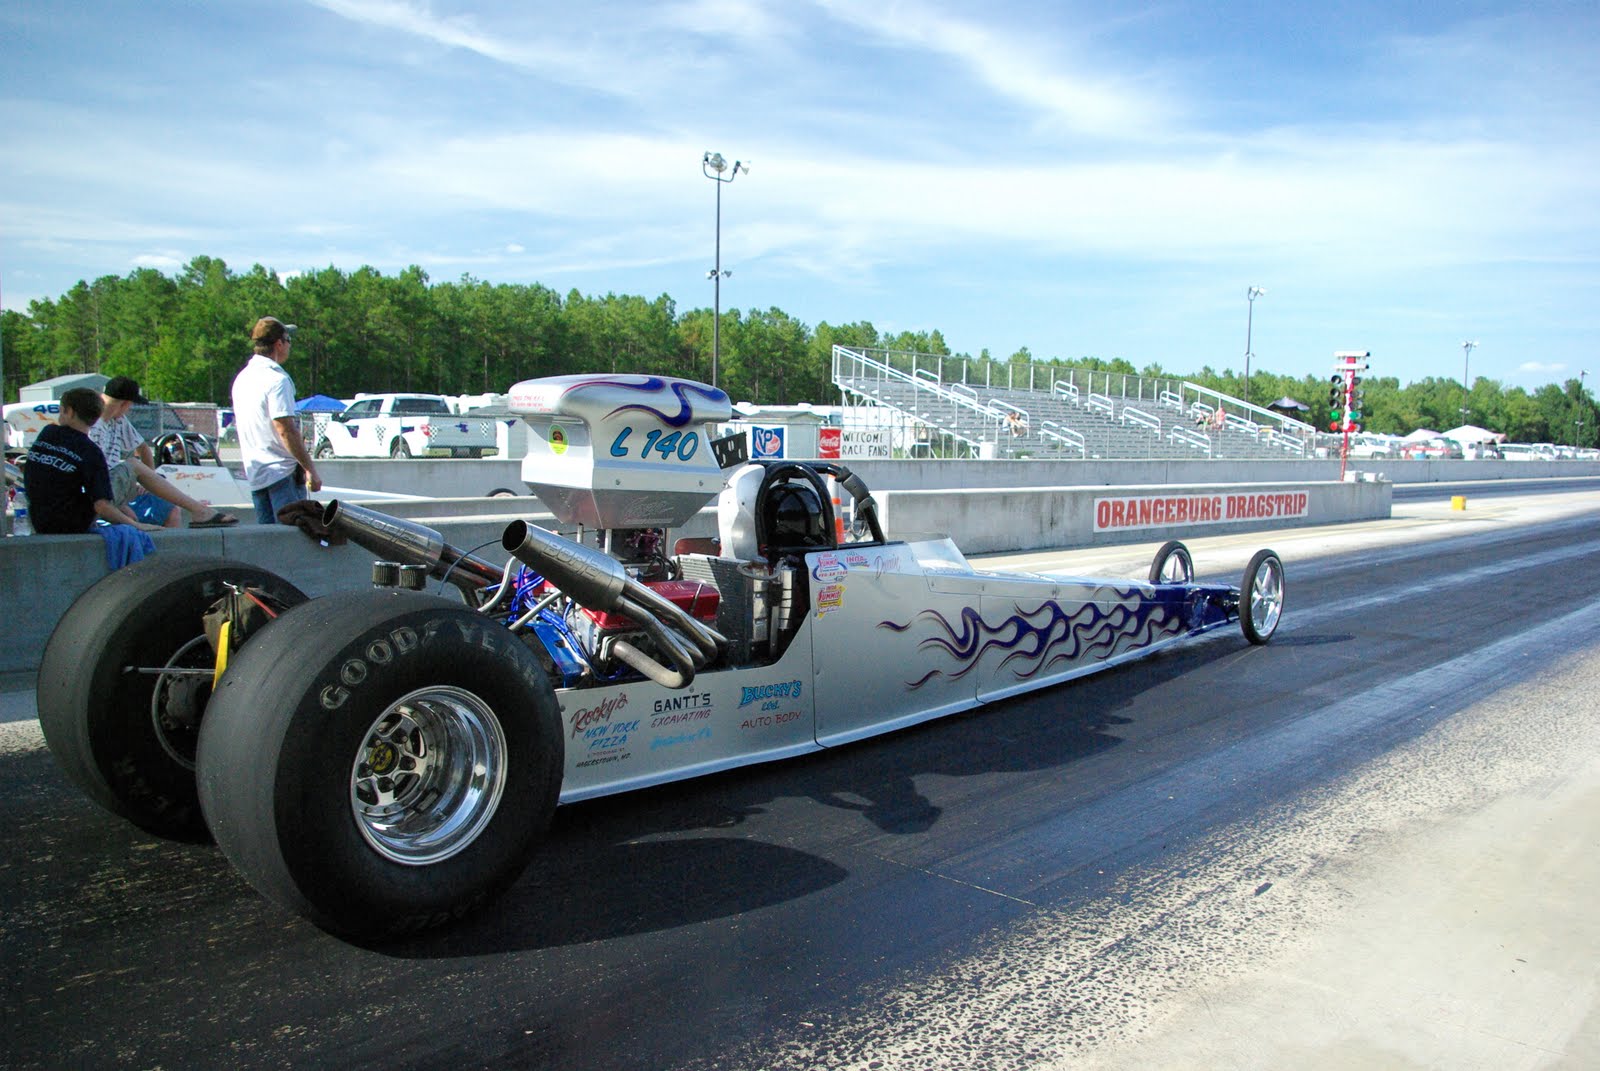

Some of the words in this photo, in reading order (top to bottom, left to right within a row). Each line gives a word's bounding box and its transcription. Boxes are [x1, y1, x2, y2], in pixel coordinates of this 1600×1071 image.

[610, 426, 632, 457] L
[641, 429, 699, 461] 140
[842, 444, 862, 455] RACE
[868, 445, 888, 456] FANS
[1097, 496, 1221, 528] ORANGEBURG
[1226, 493, 1307, 519] DRAGSTRIP
[654, 692, 711, 713] GANTT'S
[738, 680, 802, 708] BUCKY'S
[569, 692, 628, 740] Rocky's
[651, 709, 711, 728] EXCAVATING
[741, 716, 772, 729] AUTO
[775, 710, 802, 724] BODY
[584, 722, 612, 739] NEW
[612, 719, 640, 734] YORK
[589, 734, 628, 750] PIZZA
